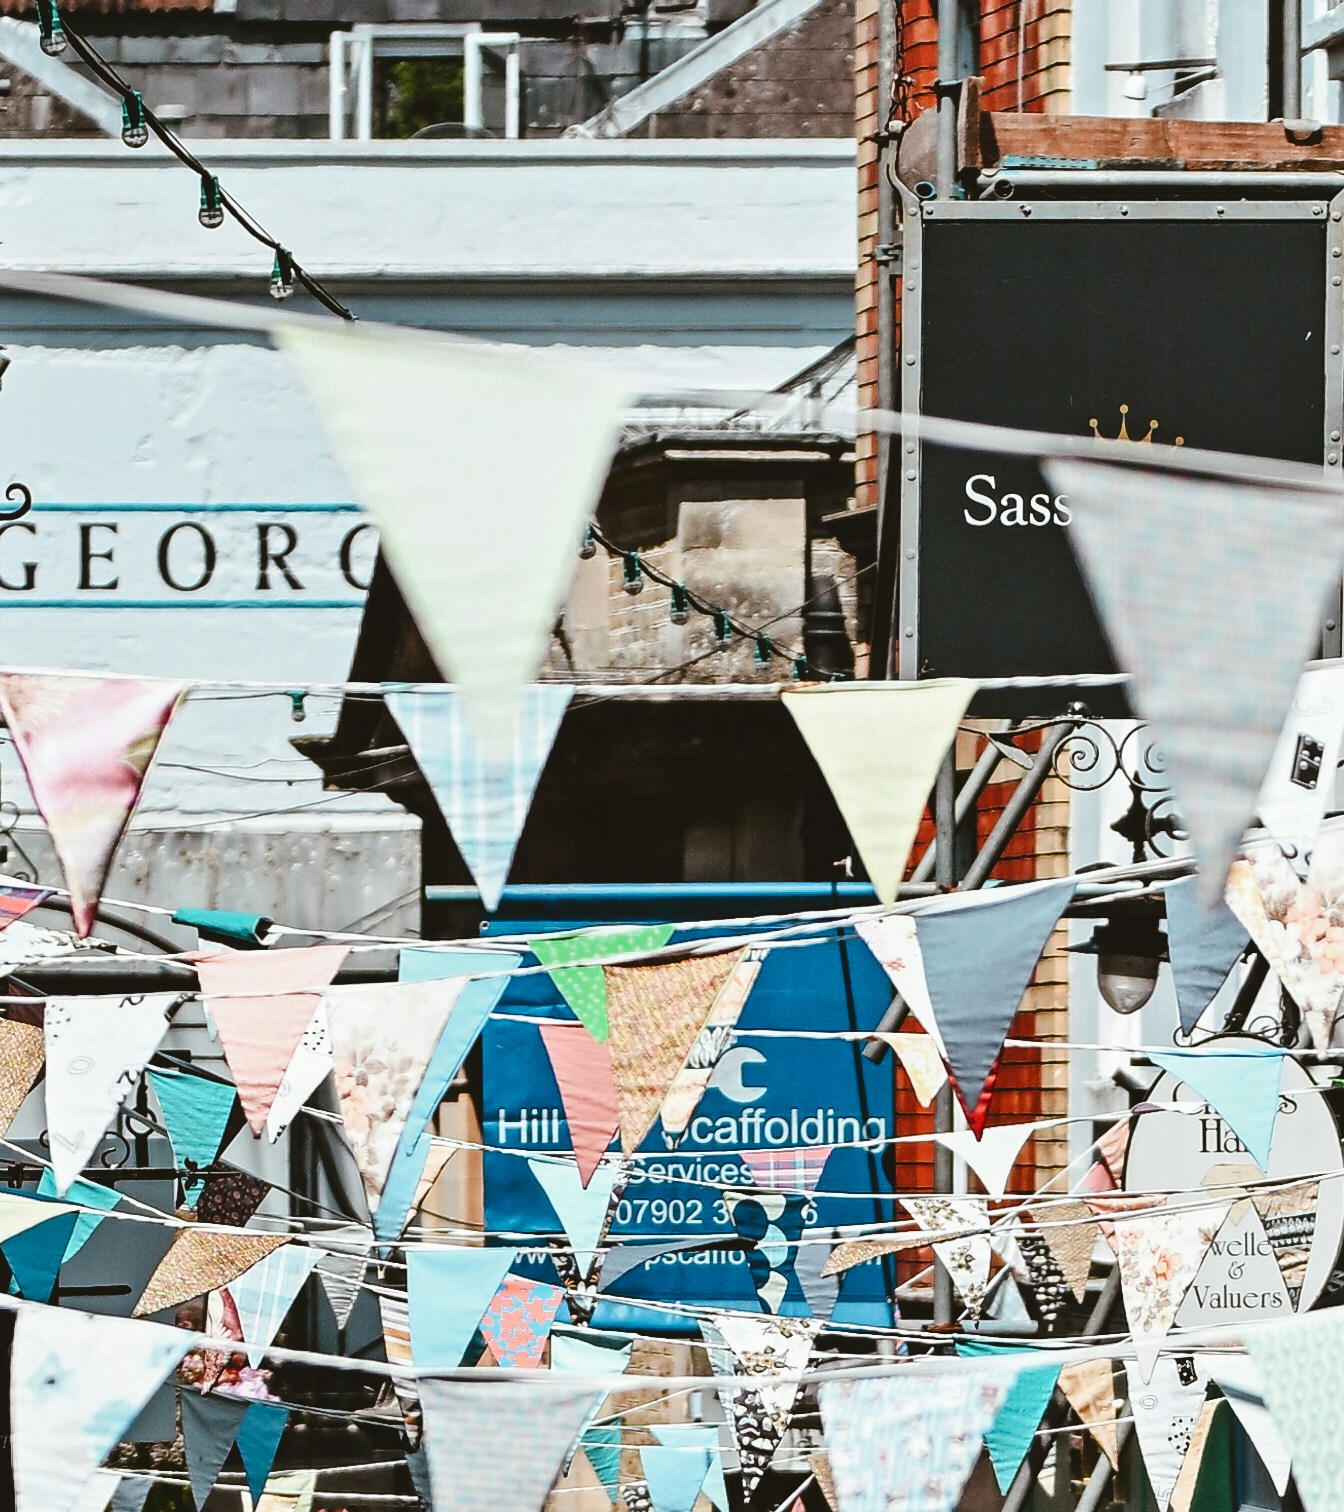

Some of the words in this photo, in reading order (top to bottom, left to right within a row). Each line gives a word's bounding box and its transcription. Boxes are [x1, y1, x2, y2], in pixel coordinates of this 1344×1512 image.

[964, 474, 1074, 529] Sass
[628, 1156, 755, 1185] Services
[615, 1198, 704, 1225] 07902
[1209, 1231, 1274, 1257] welle
[1227, 1260, 1246, 1281] &
[1193, 1283, 1285, 1310] Valuers
